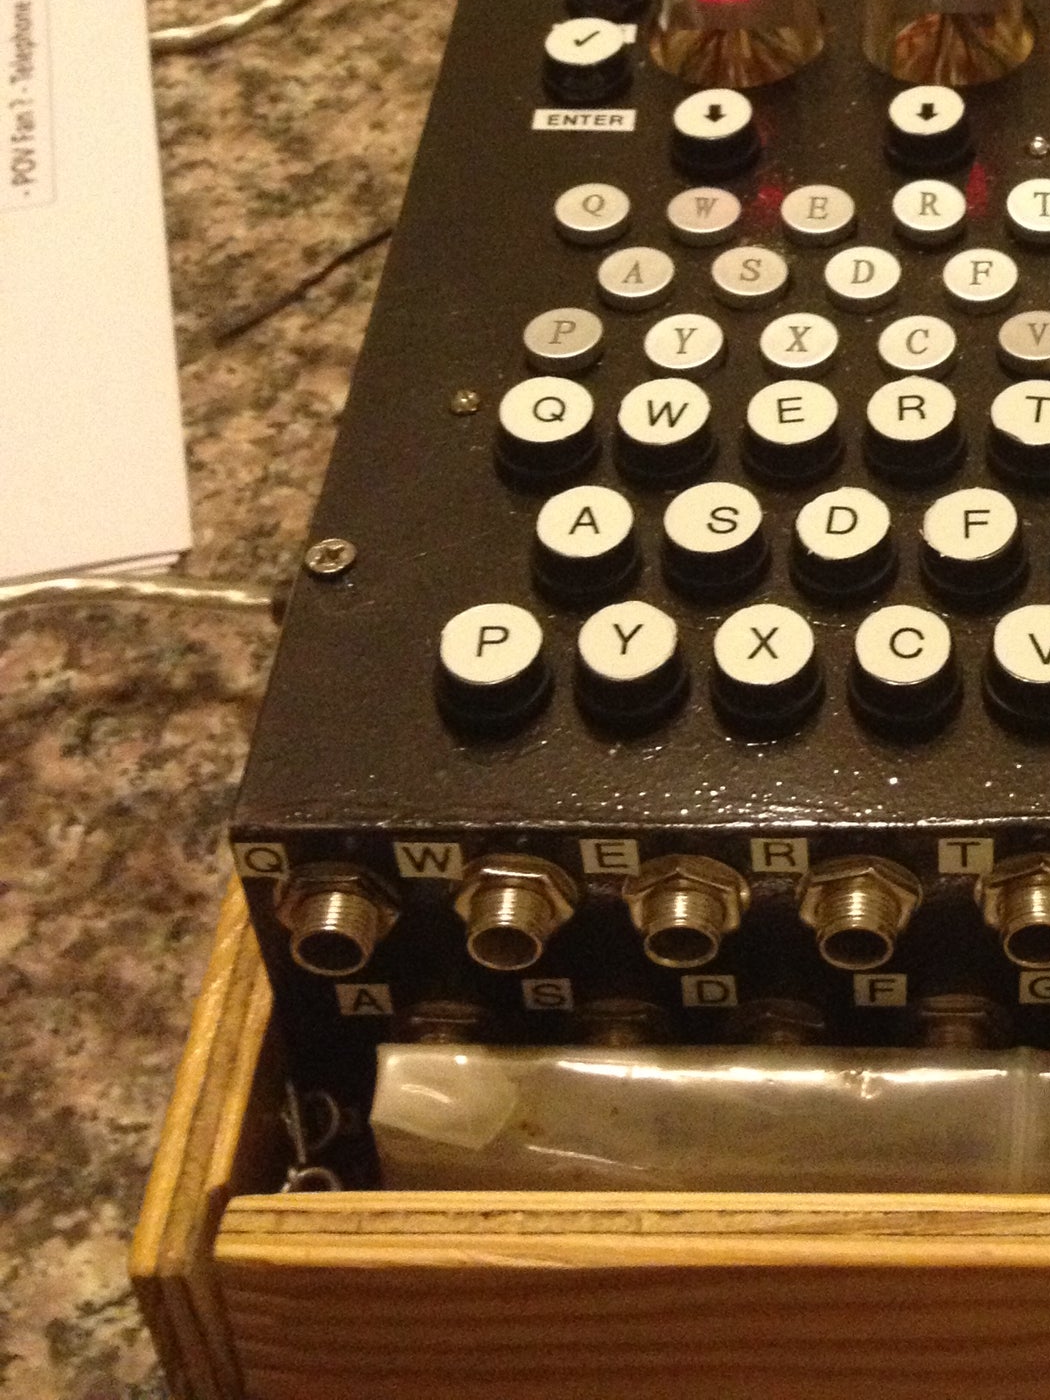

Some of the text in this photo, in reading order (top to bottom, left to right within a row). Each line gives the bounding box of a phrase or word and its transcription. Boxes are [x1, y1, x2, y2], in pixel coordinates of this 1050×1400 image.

[546, 113, 624, 127] ENTER
[581, 193, 606, 218] Q
[694, 196, 719, 218] W
[806, 195, 829, 221] E
[918, 191, 941, 217] R
[621, 260, 644, 285] A
[738, 258, 762, 283] S
[850, 259, 876, 285] D
[969, 260, 994, 286] F
[548, 319, 577, 345] P
[674, 327, 698, 355] Y
[784, 325, 812, 353] X
[905, 328, 930, 356] C
[1027, 322, 1050, 346] V
[532, 395, 567, 423] Q
[647, 399, 689, 429] W
[776, 396, 805, 425] E
[897, 394, 926, 422] R
[568, 505, 600, 535] A
[706, 505, 740, 535] S
[825, 505, 859, 536] D
[963, 509, 991, 539] F
[476, 625, 510, 658] P
[612, 623, 644, 656] Y
[747, 626, 779, 660] X
[888, 626, 925, 660] C
[244, 847, 283, 874] Q
[402, 846, 451, 873] W
[594, 841, 630, 869] E
[762, 841, 797, 868] R
[946, 840, 981, 868] T
[352, 988, 383, 1011] A
[531, 982, 562, 1006] S
[696, 980, 729, 1003] D
[868, 978, 896, 1004] F
